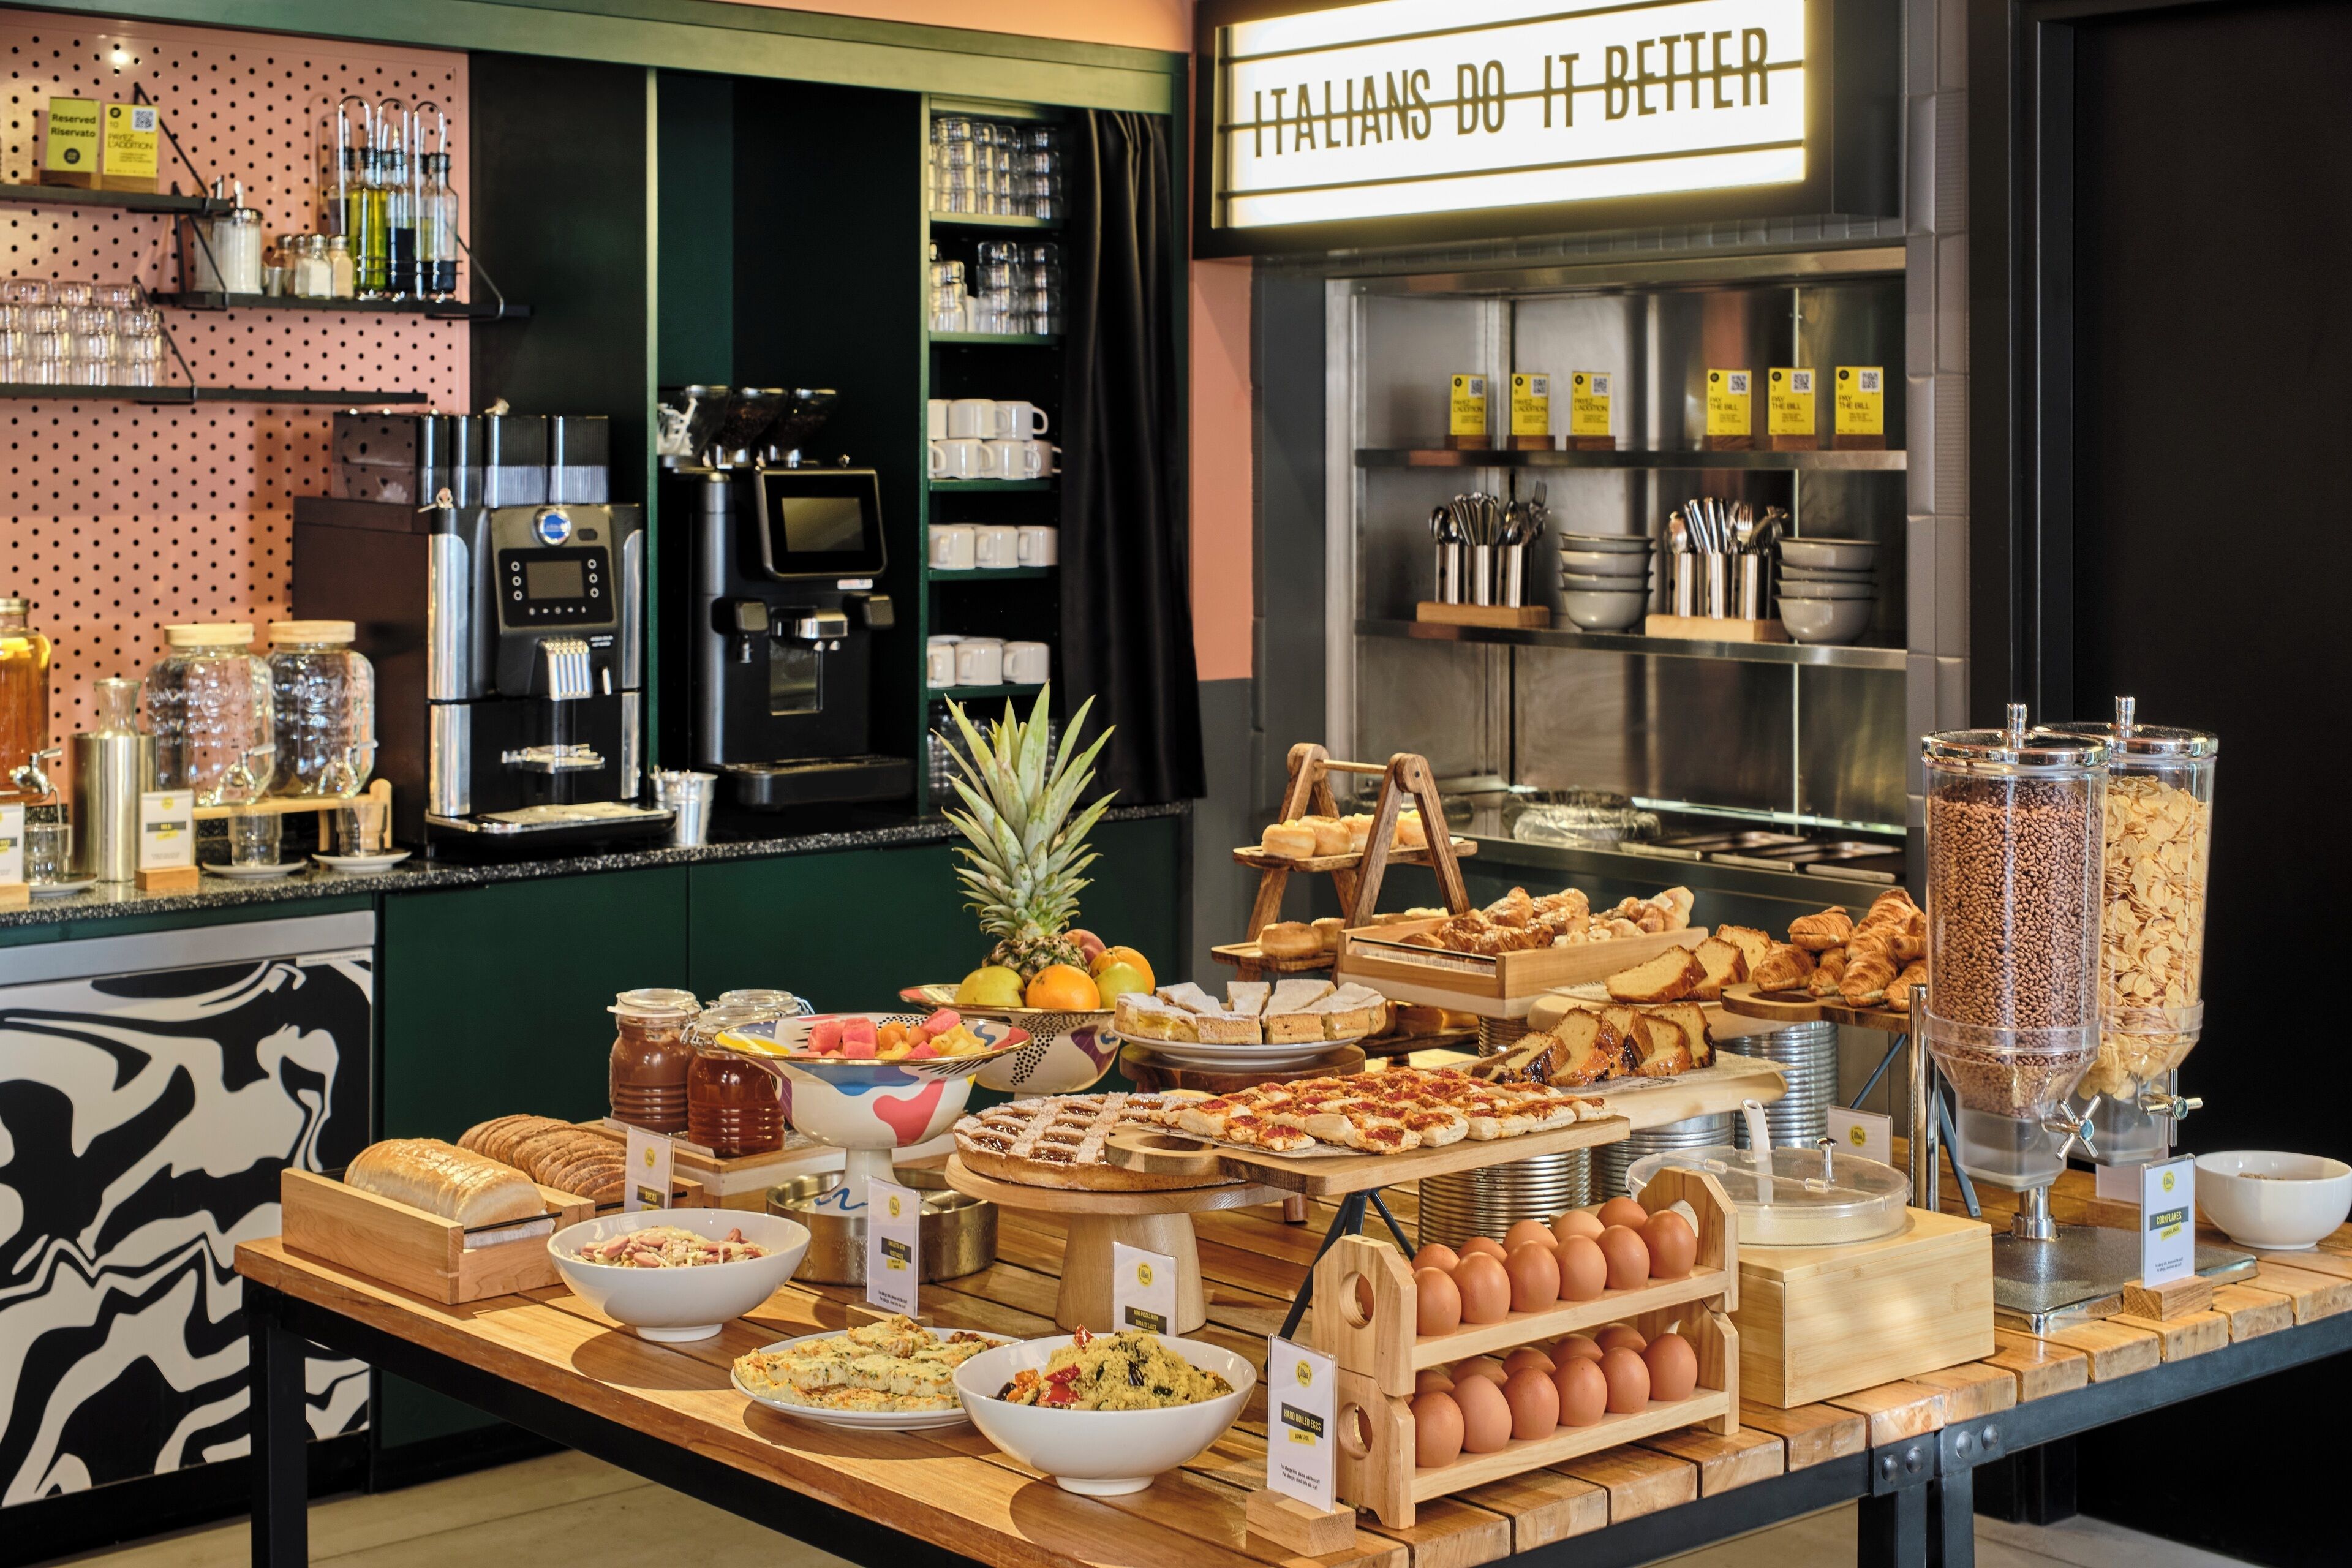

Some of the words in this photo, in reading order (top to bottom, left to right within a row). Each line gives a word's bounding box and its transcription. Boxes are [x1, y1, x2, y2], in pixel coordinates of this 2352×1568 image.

[1254, 69, 1431, 158] ITALIANS
[1457, 60, 1506, 135] DO
[1544, 53, 1580, 129] IT
[1605, 27, 1769, 120] BETTER
[52, 113, 96, 124] Reserved
[51, 127, 96, 138] Riservato
[108, 133, 134, 141] PAYEZ
[645, 1191, 657, 1203] BREAD
[2156, 1210, 2182, 1226] CORNFLAKES
[2163, 1225, 2179, 1237] CORNFLAKES
[1140, 1310, 1151, 1319] PIZZAS
[1135, 1319, 1147, 1329] TOMATO
[1284, 1408, 1295, 1421] HARD
[1295, 1413, 1310, 1427] BOILED
[1310, 1419, 1321, 1432] EGGS
